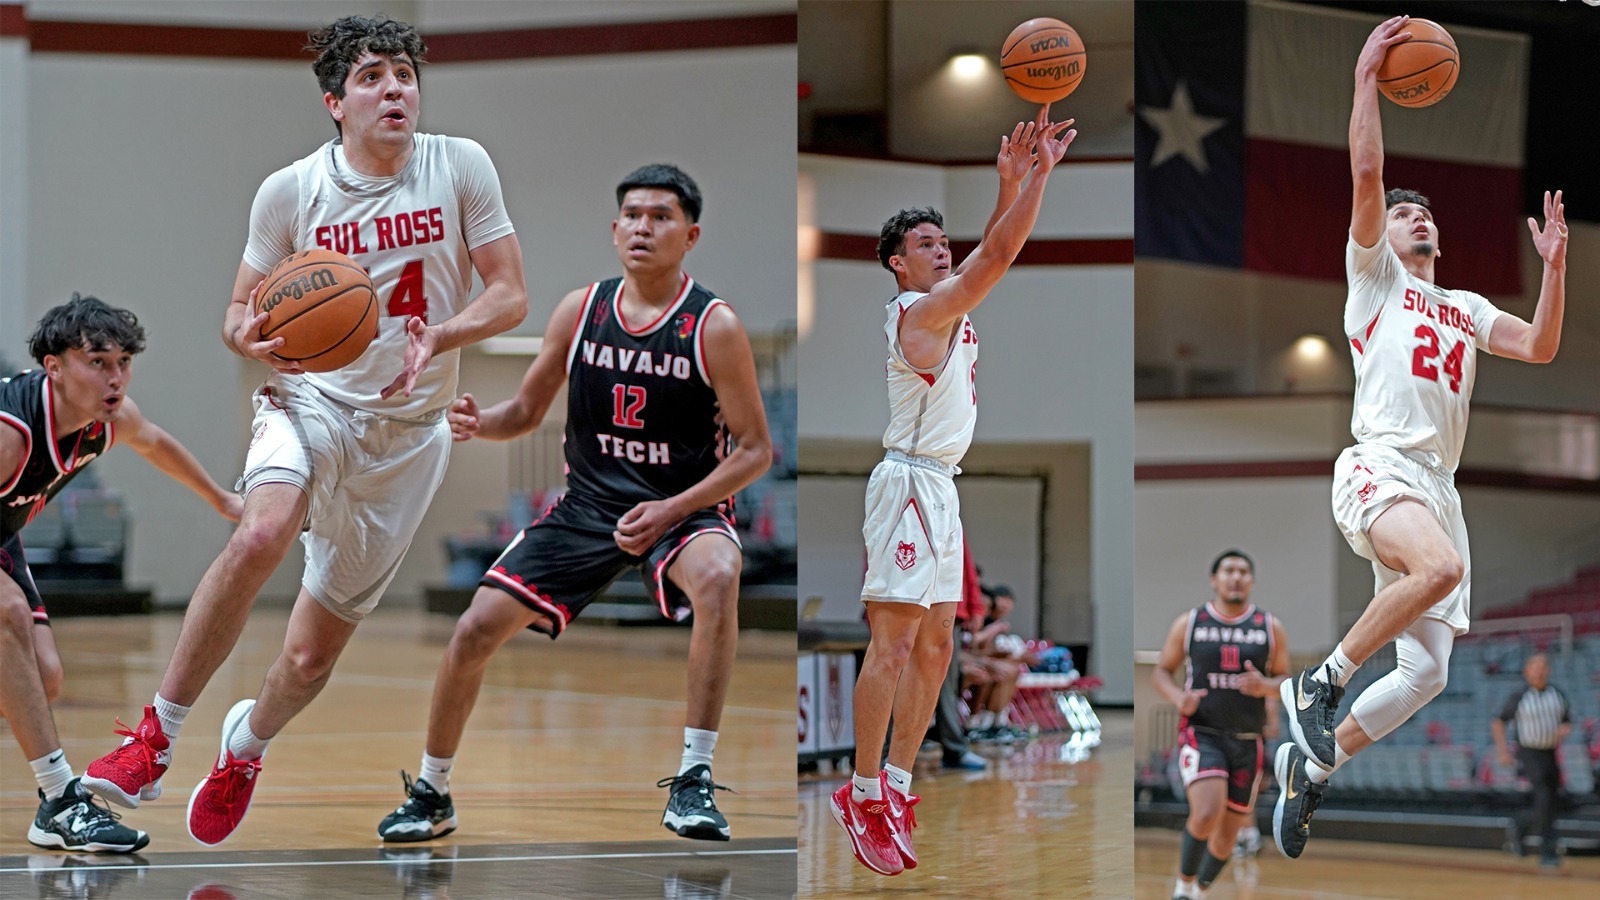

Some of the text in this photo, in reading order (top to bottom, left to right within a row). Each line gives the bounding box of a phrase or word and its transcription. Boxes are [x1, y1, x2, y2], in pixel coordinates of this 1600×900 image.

[1030, 37, 1068, 54] NCAA
[1027, 61, 1079, 80] Wilson
[1390, 81, 1430, 99] NCAA
[316, 206, 445, 256] SUL ROSS
[262, 268, 338, 312] Wilson
[1403, 288, 1476, 338] SUL ROSS
[581, 339, 691, 381] NAVAJO
[1411, 324, 1466, 394] 24
[611, 383, 647, 429] 12
[596, 433, 671, 465] TECH
[1195, 627, 1266, 644] NAVAJO
[1221, 645, 1240, 669] 11
